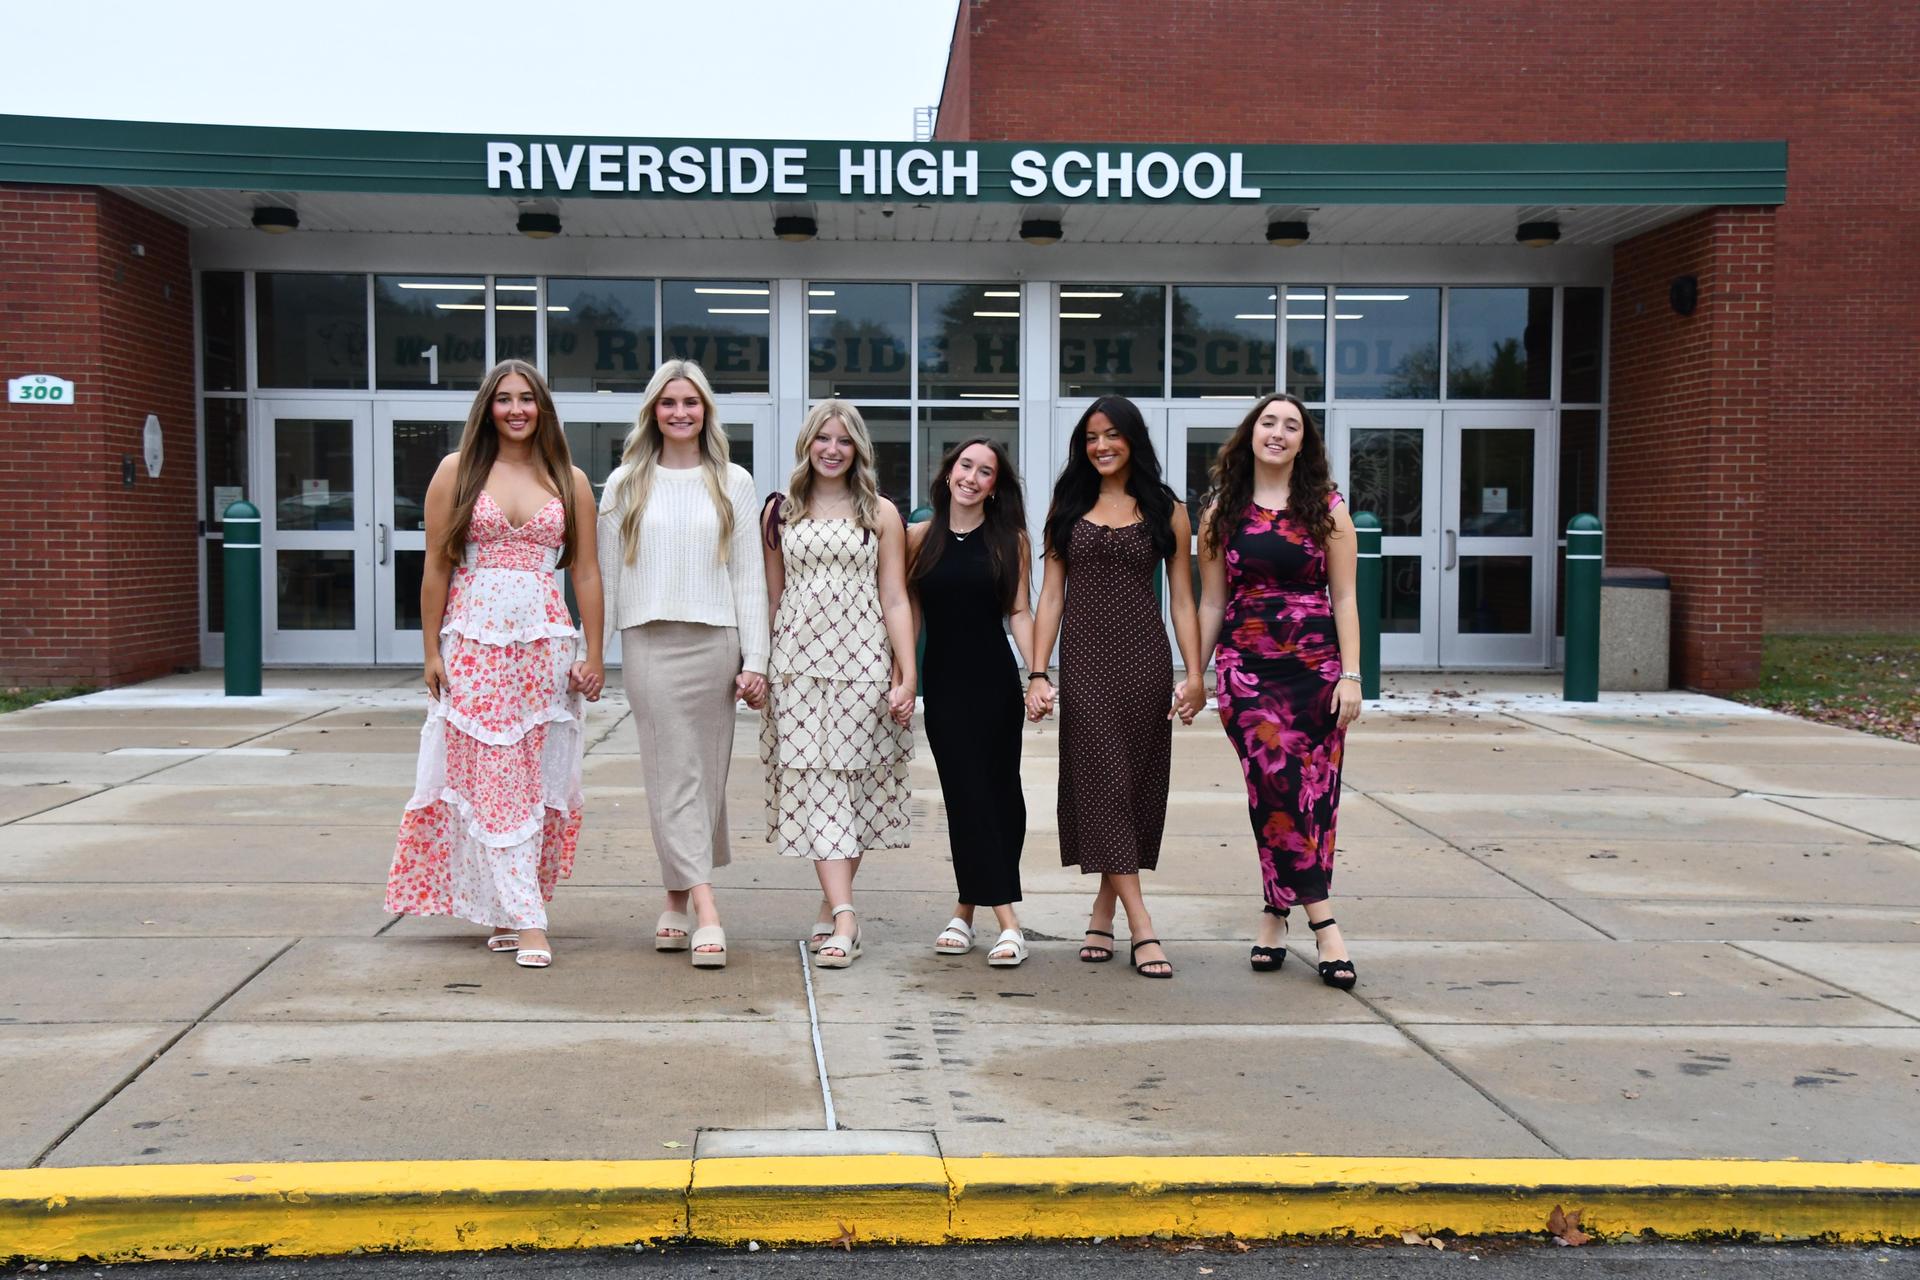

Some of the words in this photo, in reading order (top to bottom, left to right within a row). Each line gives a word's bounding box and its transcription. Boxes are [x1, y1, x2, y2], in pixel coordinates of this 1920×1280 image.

[487, 142, 807, 194] RIVERSIDE
[839, 148, 979, 196] HIGH
[1009, 150, 1261, 199] SCHOOL
[421, 344, 438, 385] 1
[973, 334, 1133, 374] HGH
[19, 385, 63, 400] 300
